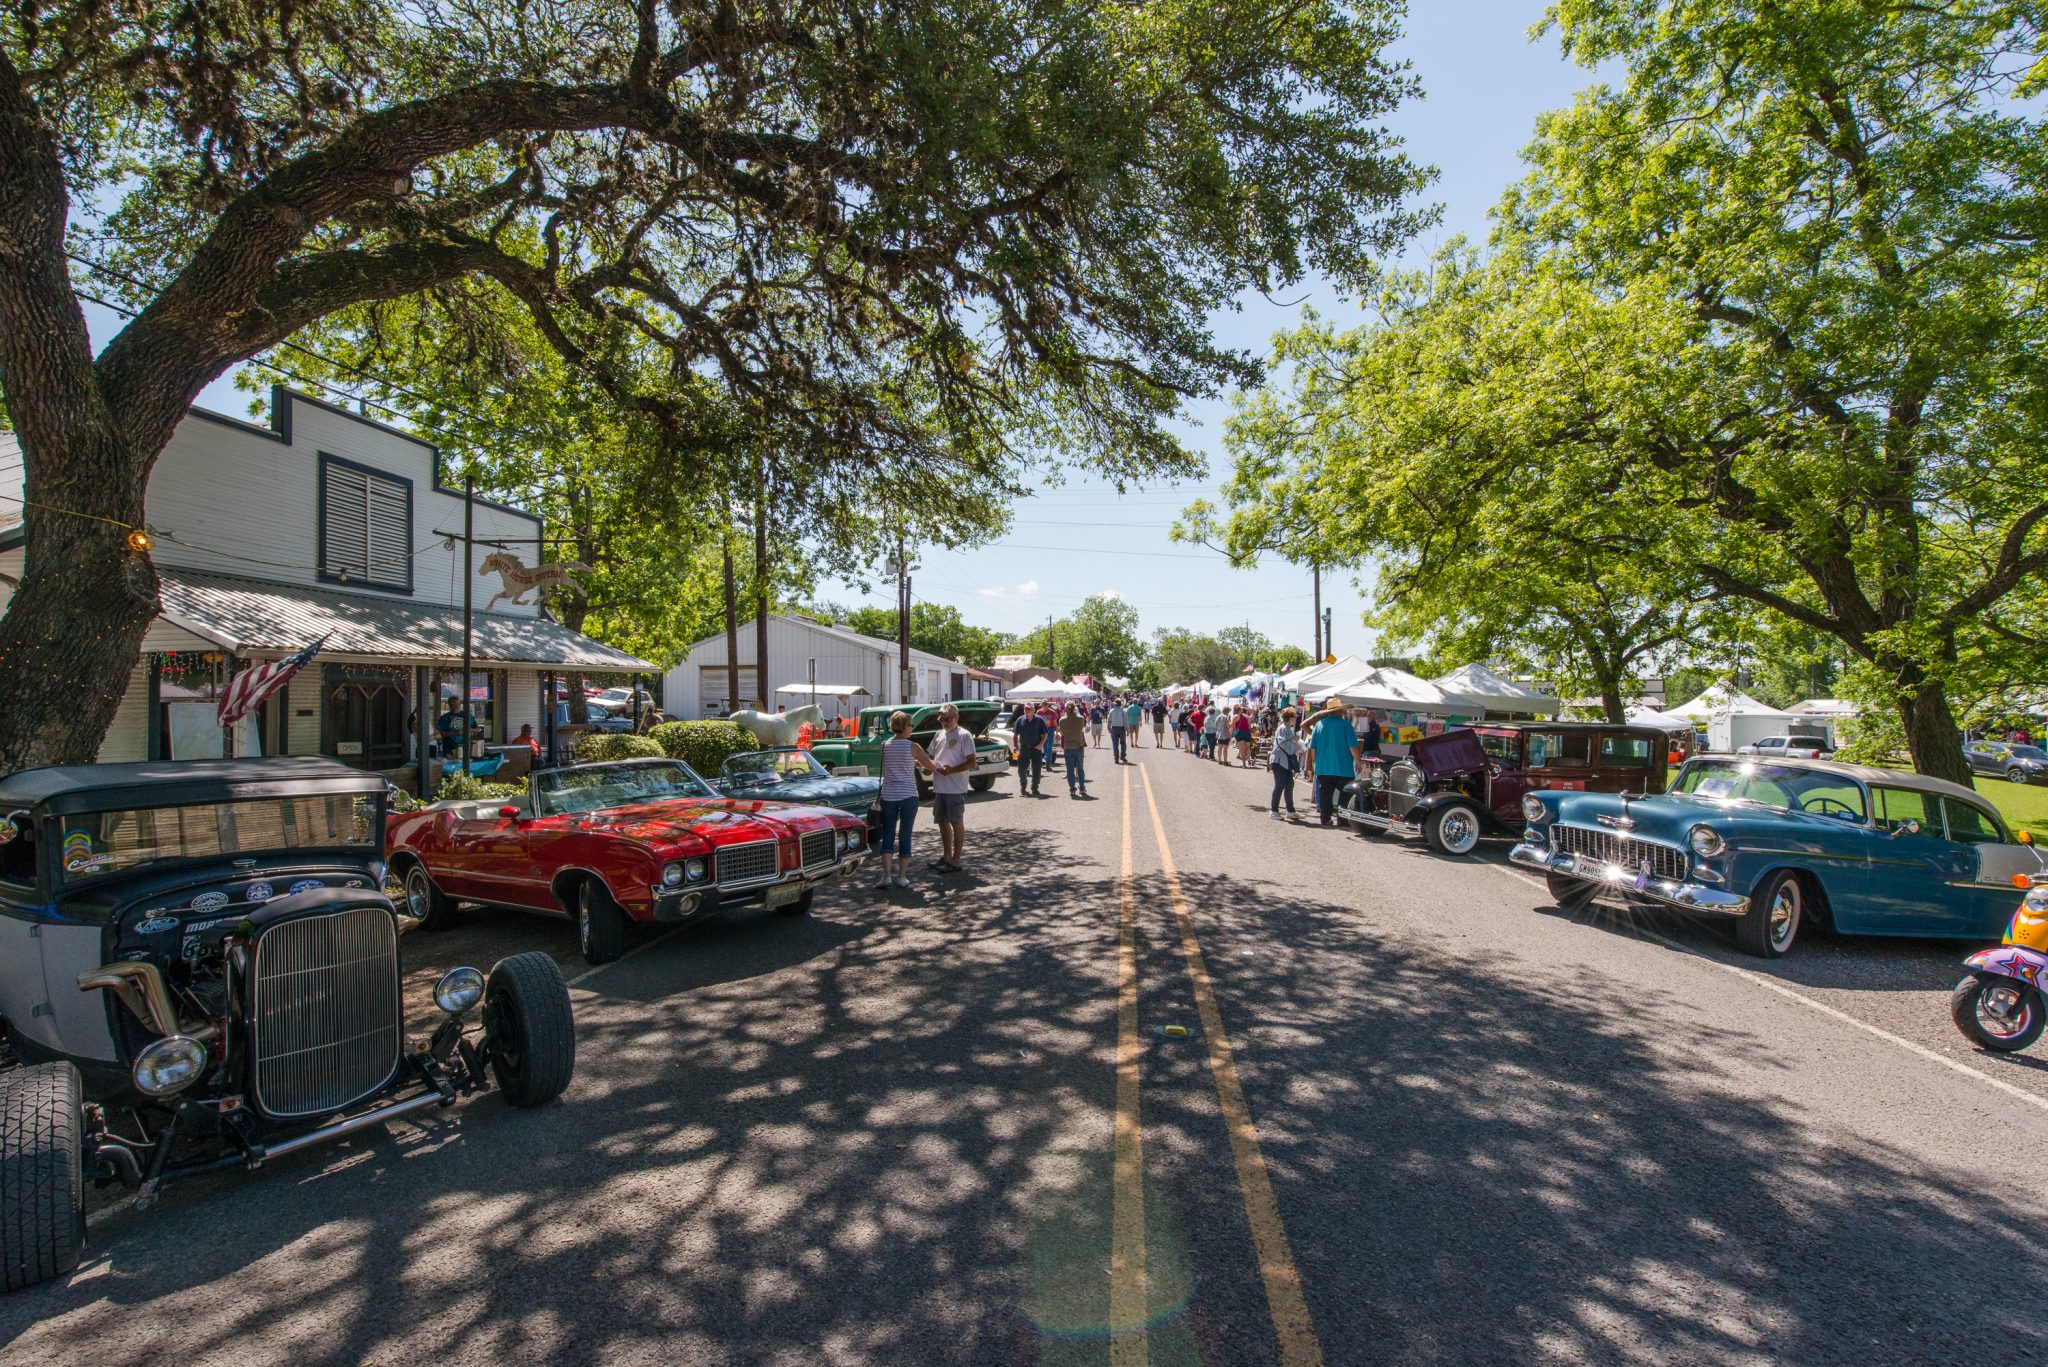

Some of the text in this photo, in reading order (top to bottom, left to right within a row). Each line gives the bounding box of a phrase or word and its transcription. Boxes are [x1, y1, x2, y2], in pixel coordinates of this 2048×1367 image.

[488, 559, 562, 584] WHITE HORSE TAVERN
